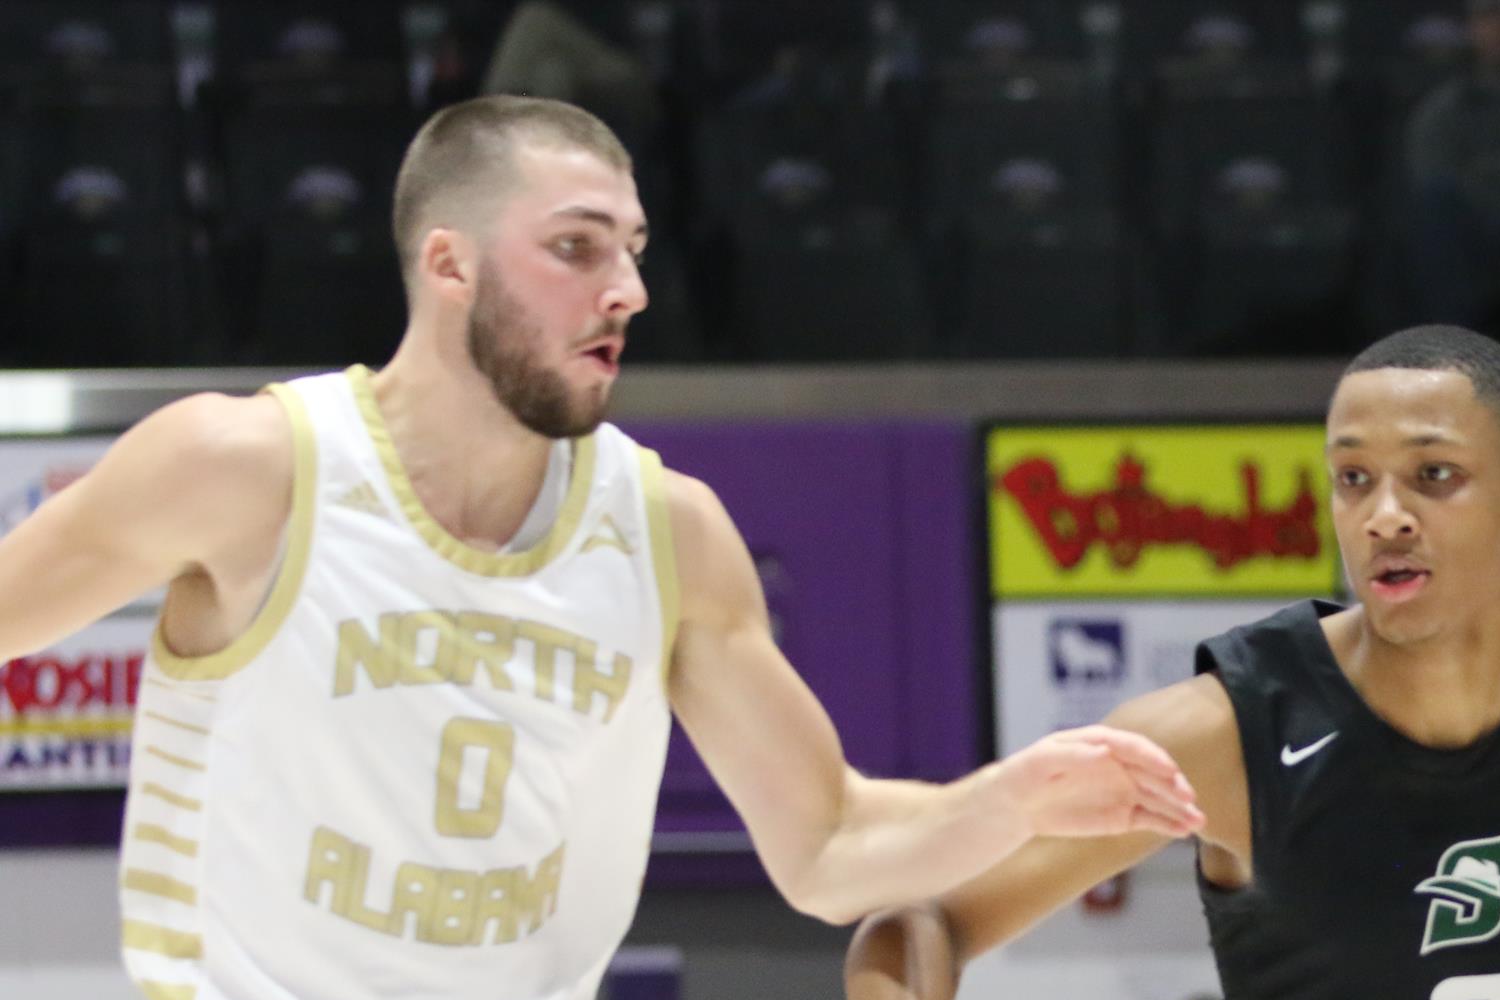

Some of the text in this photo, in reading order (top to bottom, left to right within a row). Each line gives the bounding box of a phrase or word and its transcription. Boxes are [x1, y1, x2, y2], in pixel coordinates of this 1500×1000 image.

[332, 608, 634, 725] NORTH
[434, 715, 515, 840] 0
[303, 824, 566, 946] ALABAMA
